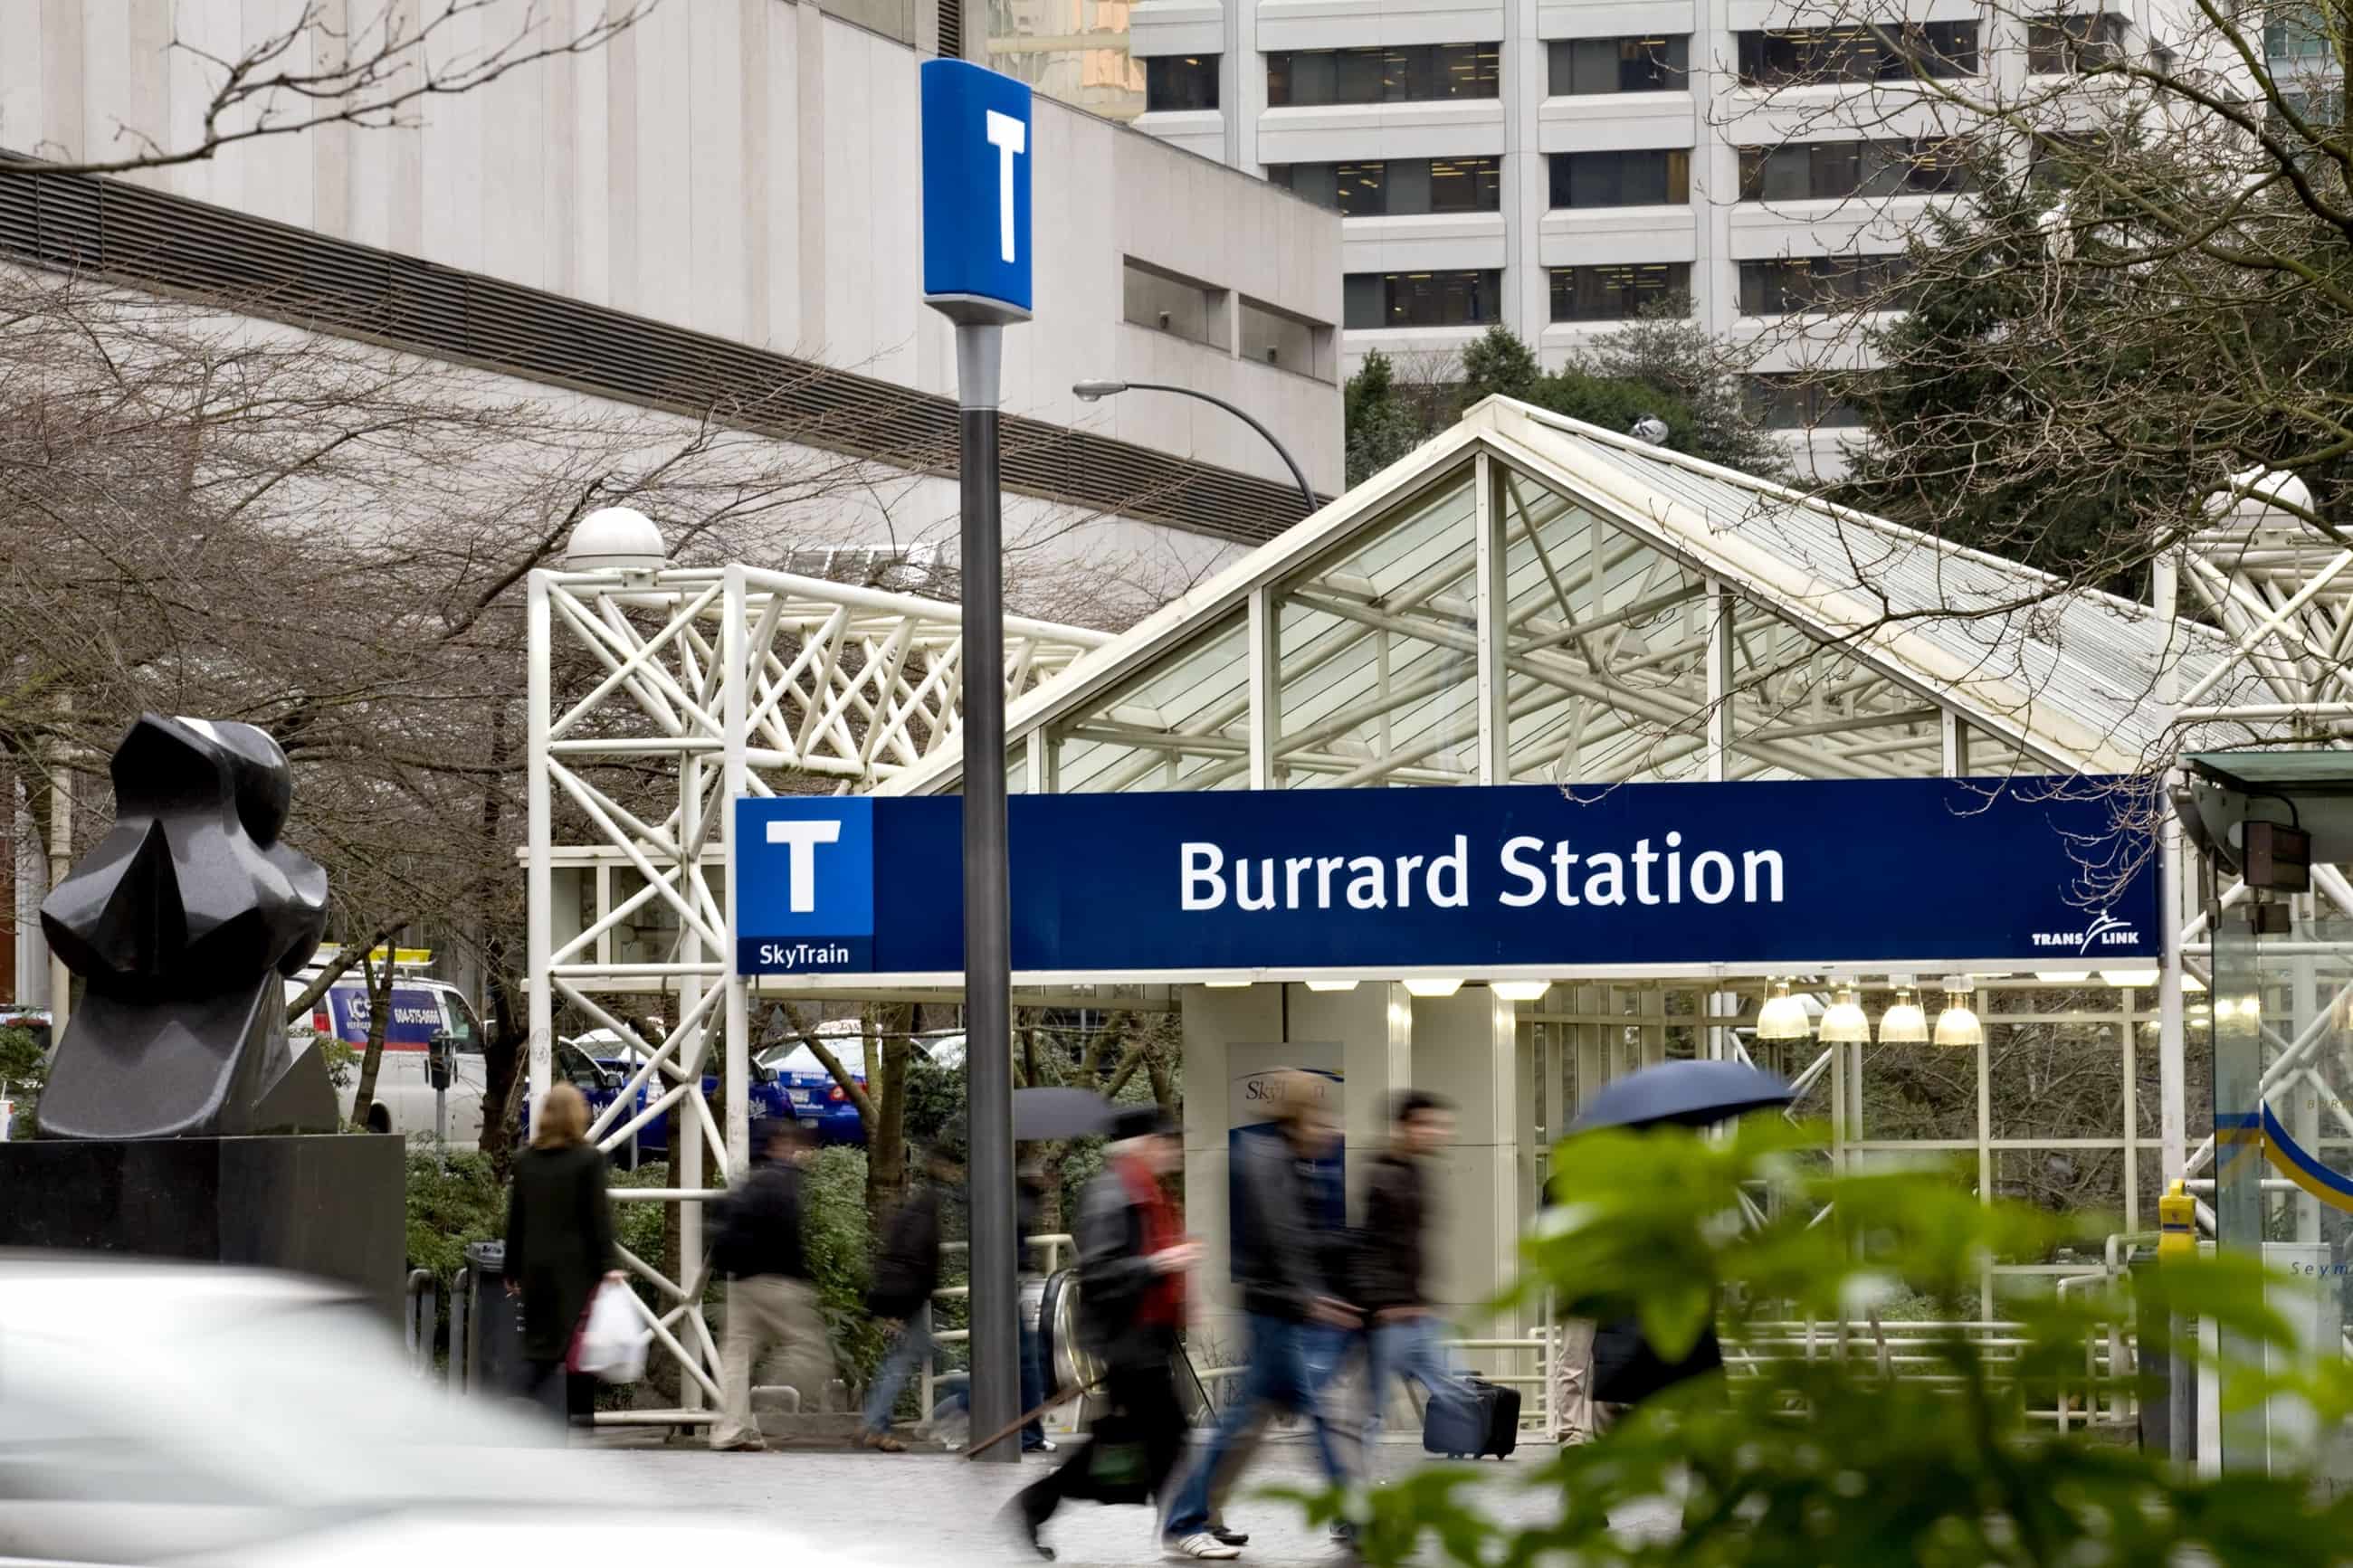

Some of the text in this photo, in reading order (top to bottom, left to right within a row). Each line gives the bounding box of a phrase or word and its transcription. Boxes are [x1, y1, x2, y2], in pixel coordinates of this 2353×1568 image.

[986, 109, 1025, 263] T
[766, 820, 842, 913] T
[1181, 831, 1784, 911] Burrard Station
[759, 943, 849, 969] SkyTrain
[2032, 932, 2139, 946] TRANS LINK
